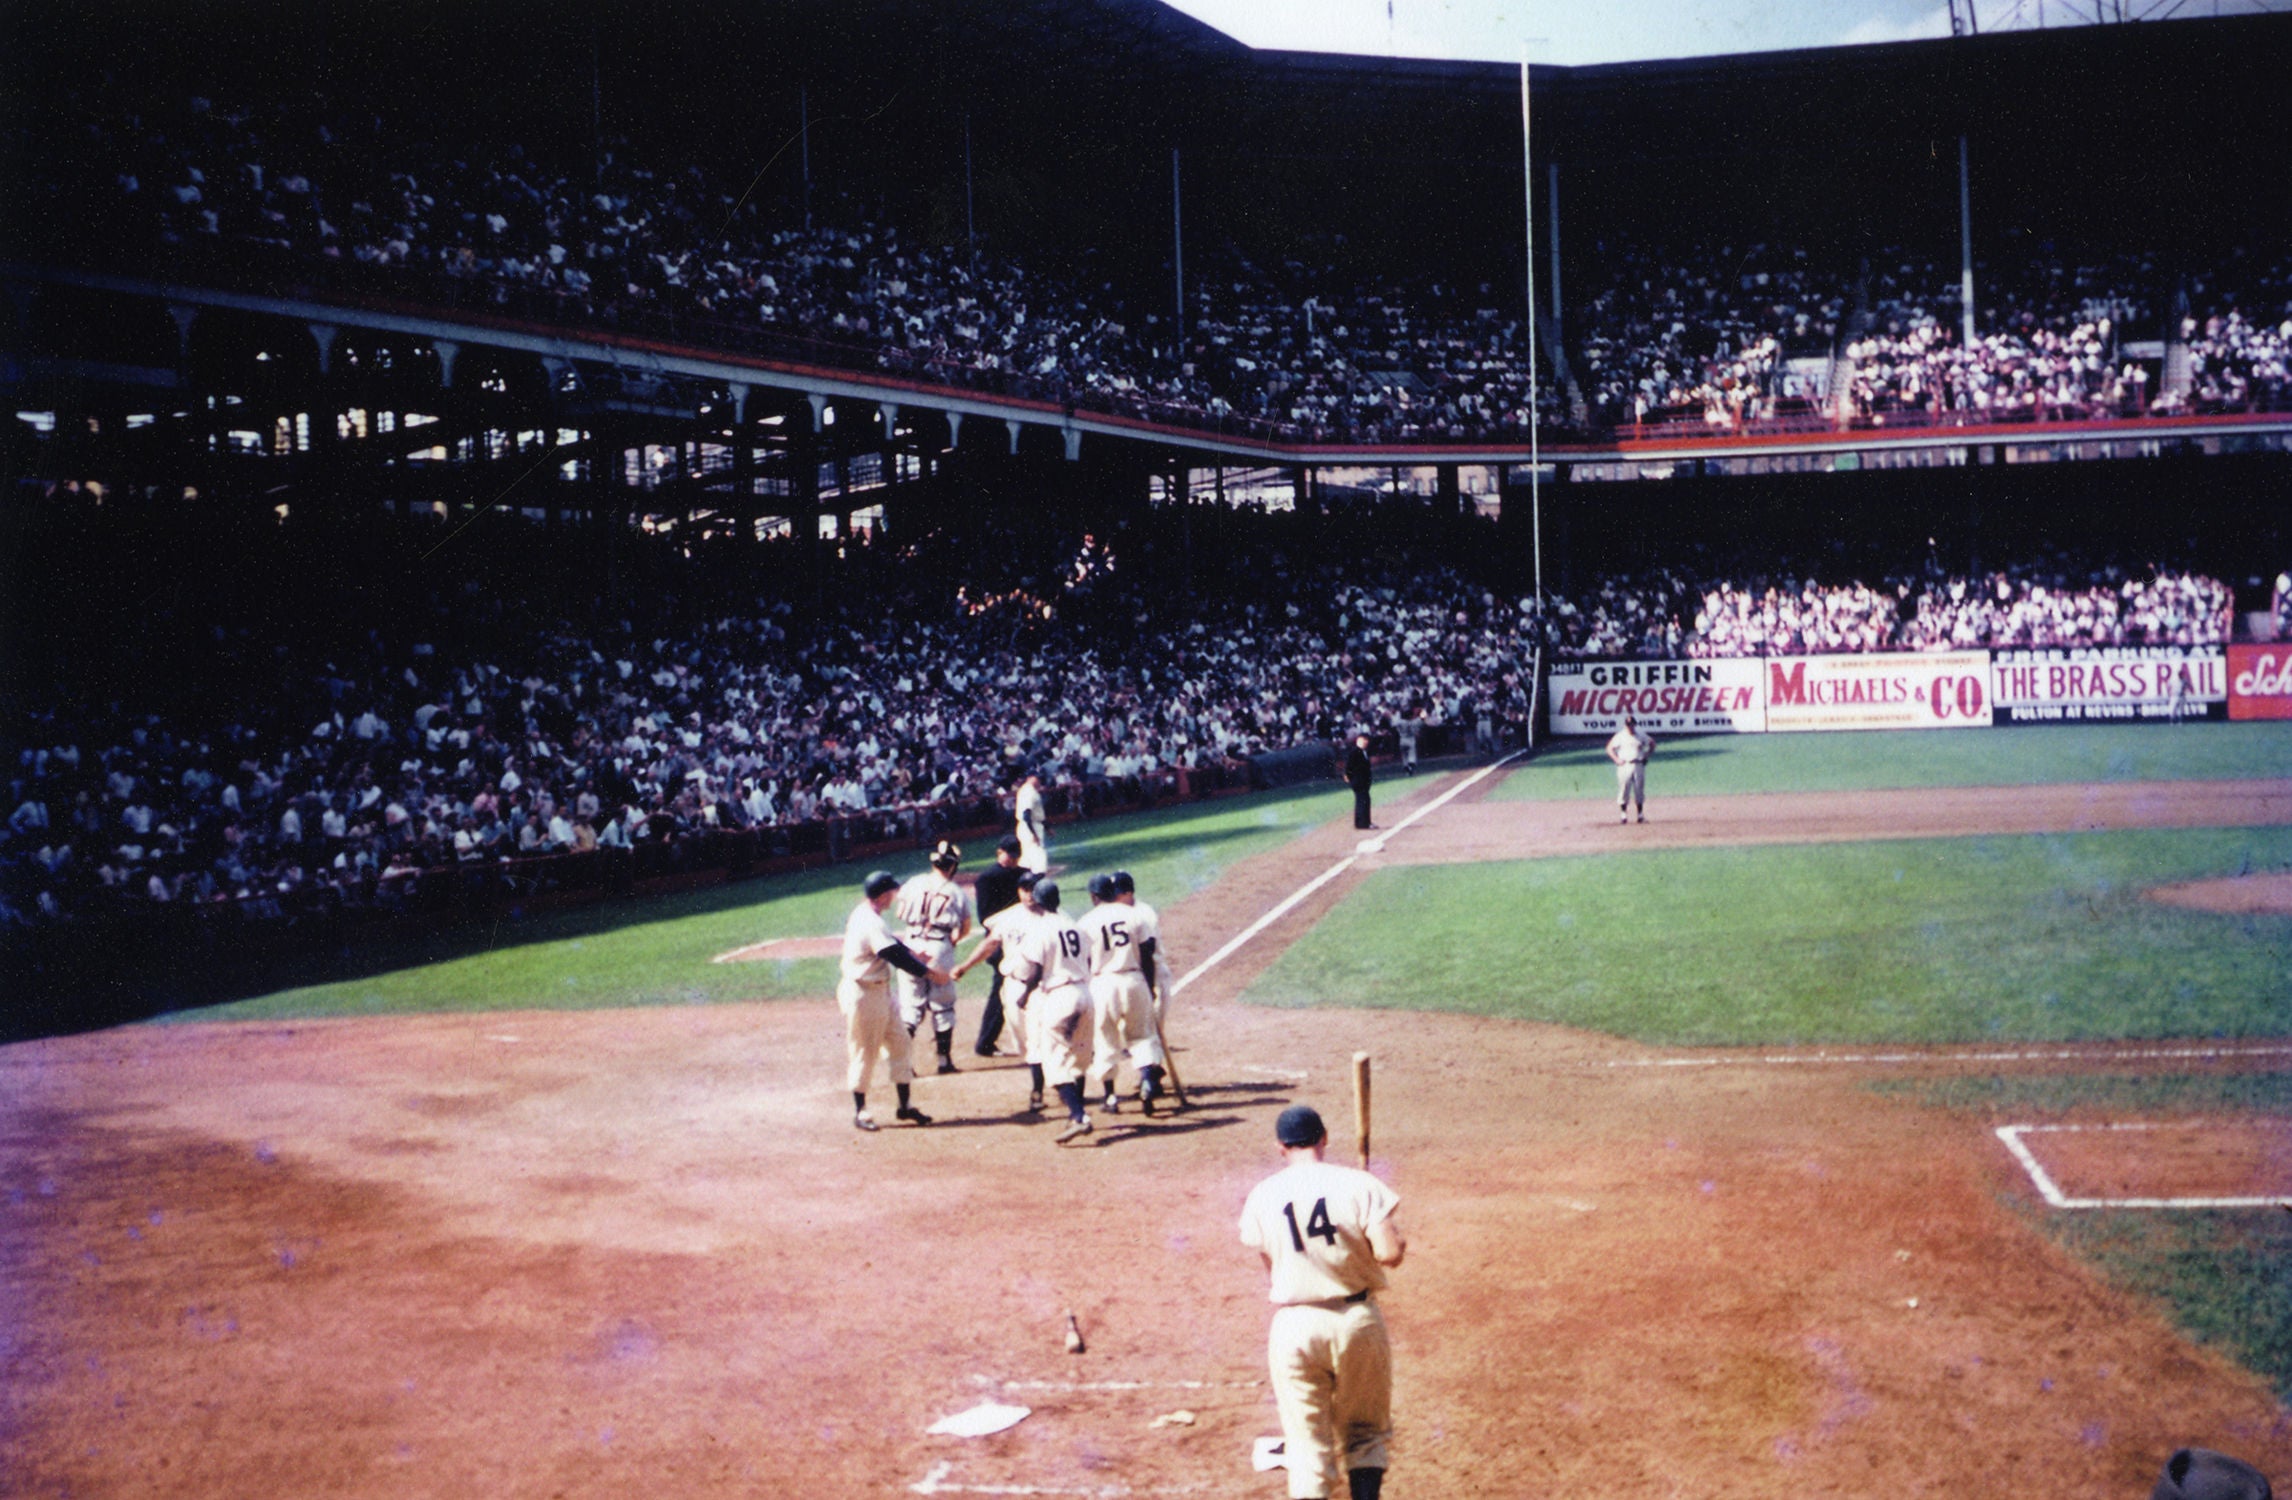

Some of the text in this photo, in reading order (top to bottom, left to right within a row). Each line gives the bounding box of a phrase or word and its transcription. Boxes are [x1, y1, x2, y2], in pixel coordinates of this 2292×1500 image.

[1590, 666, 1712, 686] GRIFFIN
[1770, 662, 1988, 719] MICHAELS & CO.
[1996, 668, 2040, 700] THE
[2049, 664, 2147, 698] BRASS
[1558, 686, 1754, 716] MICROSHEEN
[1582, 720, 1617, 729] YOUR
[1670, 718, 1685, 727] OF
[1059, 929, 1081, 958] 19
[1101, 921, 1130, 951] 15
[1283, 1197, 1337, 1253] 14
